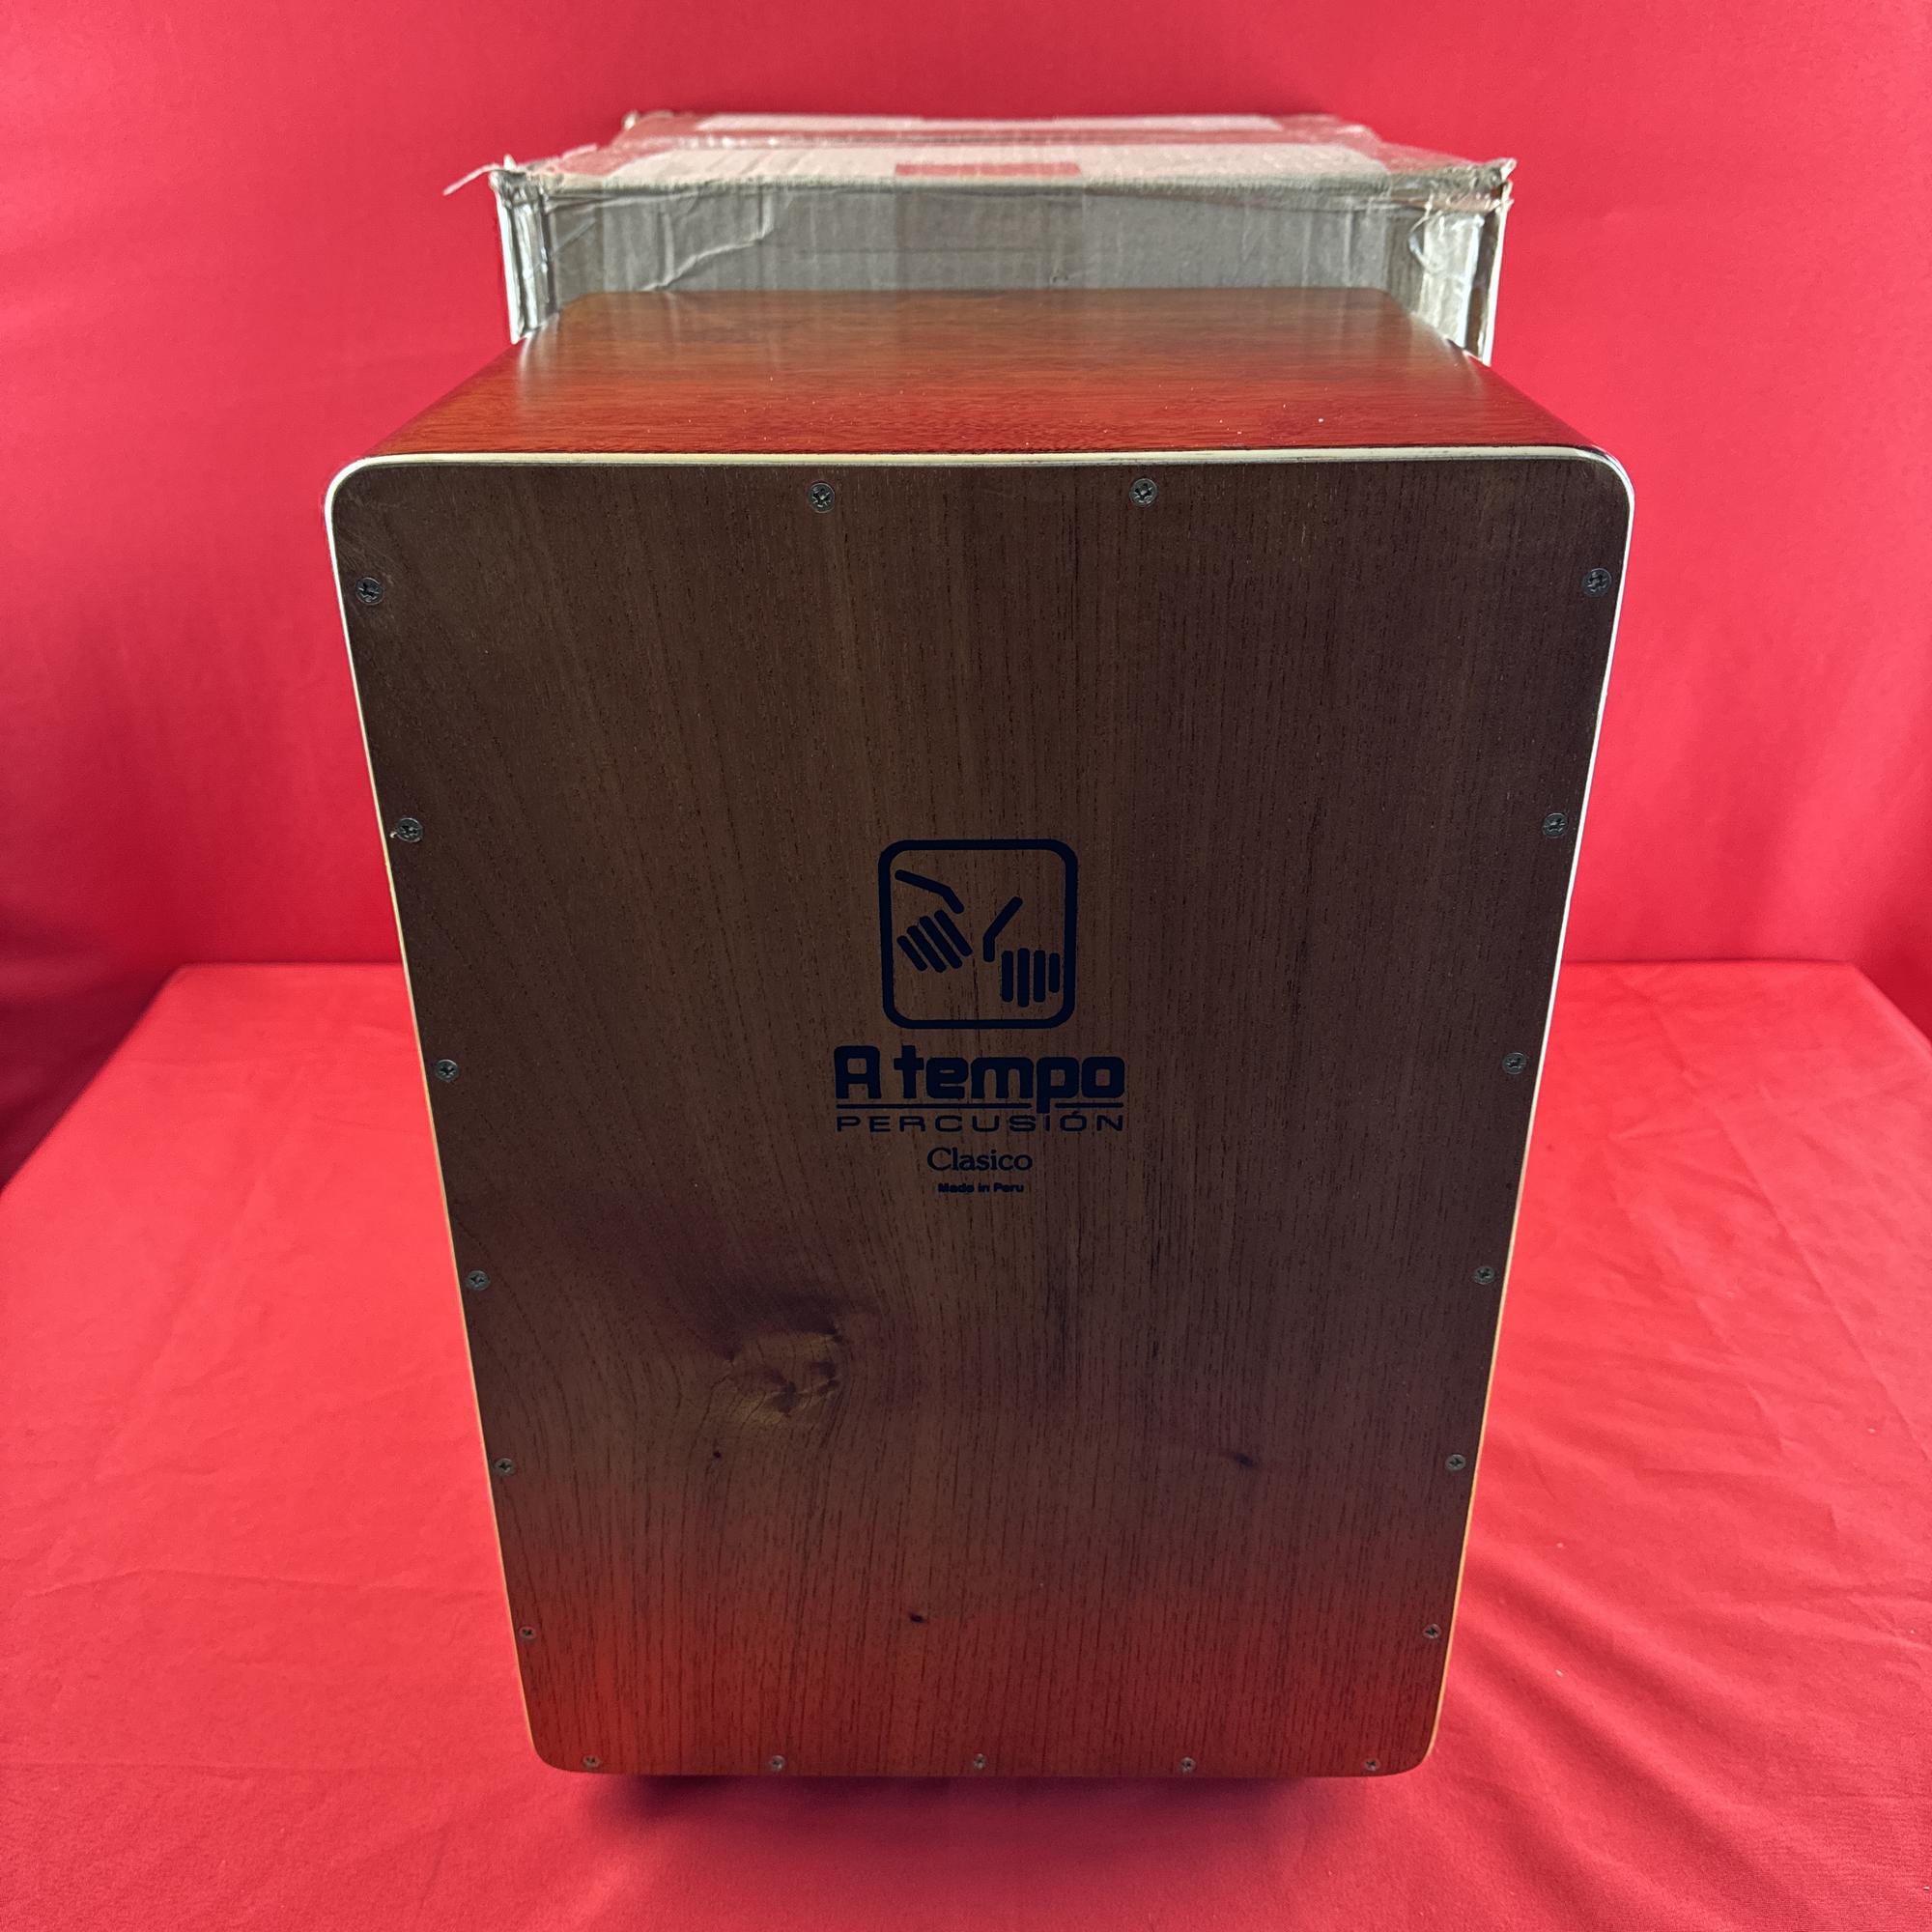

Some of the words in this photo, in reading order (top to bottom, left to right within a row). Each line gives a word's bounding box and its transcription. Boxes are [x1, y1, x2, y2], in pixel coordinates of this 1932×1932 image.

[834, 1045, 882, 1099] A
[894, 1043, 1125, 1114] tempo
[837, 1111, 1124, 1132] PERCUSIÓN
[926, 1147, 1034, 1172] Clasico
[938, 1182, 975, 1193] Made
[978, 1182, 990, 1193] in
[993, 1182, 1025, 1193] Peru
